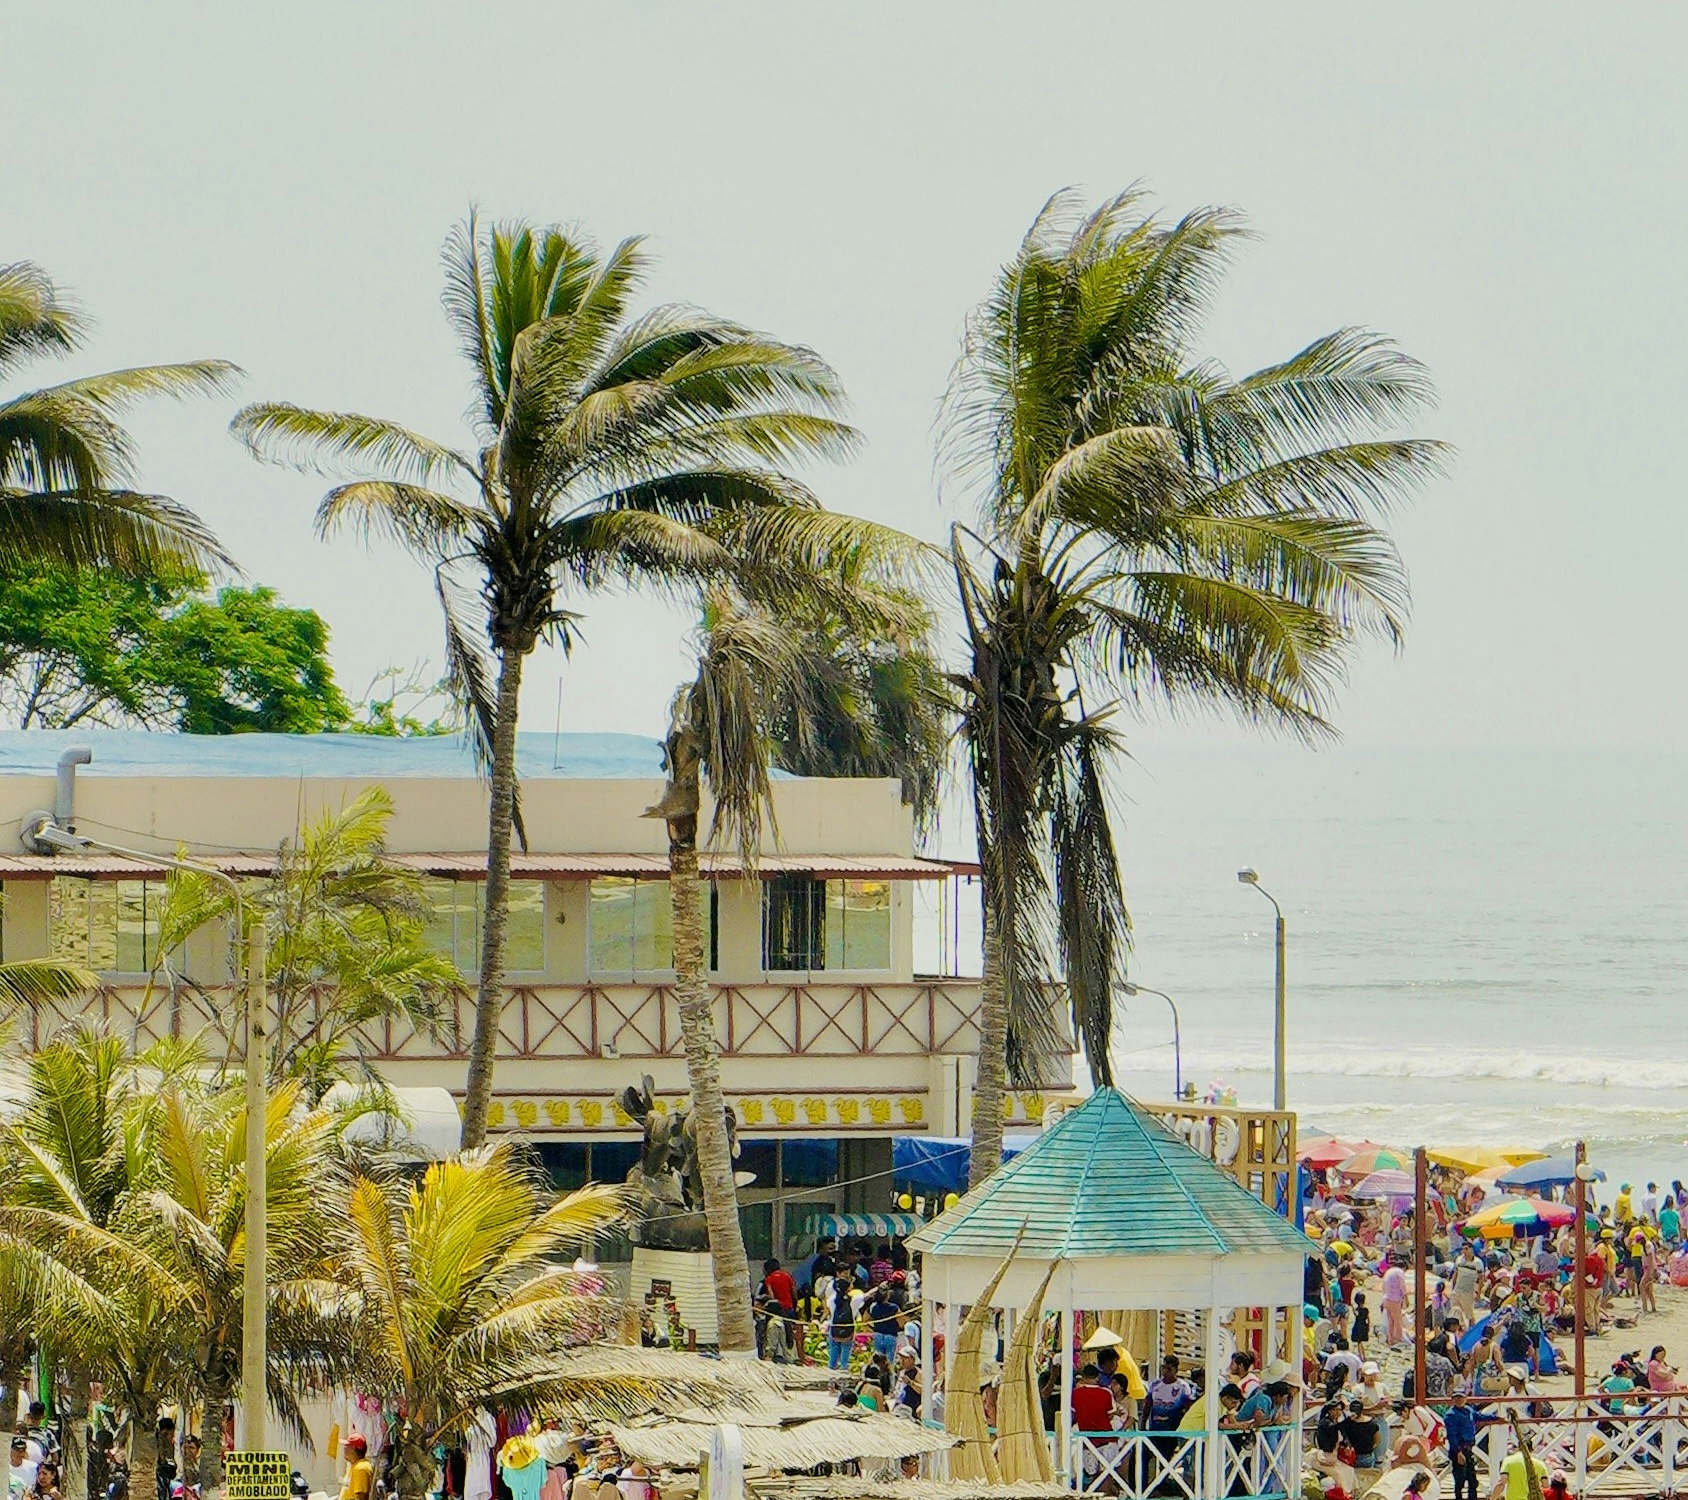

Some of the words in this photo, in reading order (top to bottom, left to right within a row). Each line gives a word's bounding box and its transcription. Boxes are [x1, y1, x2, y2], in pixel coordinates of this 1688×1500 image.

[226, 1452, 288, 1463] ALQUILO
[229, 1464, 287, 1475] MINI
[227, 1474, 289, 1486] DEPARTAMENTO
[228, 1485, 288, 1498] AMOBLADO
